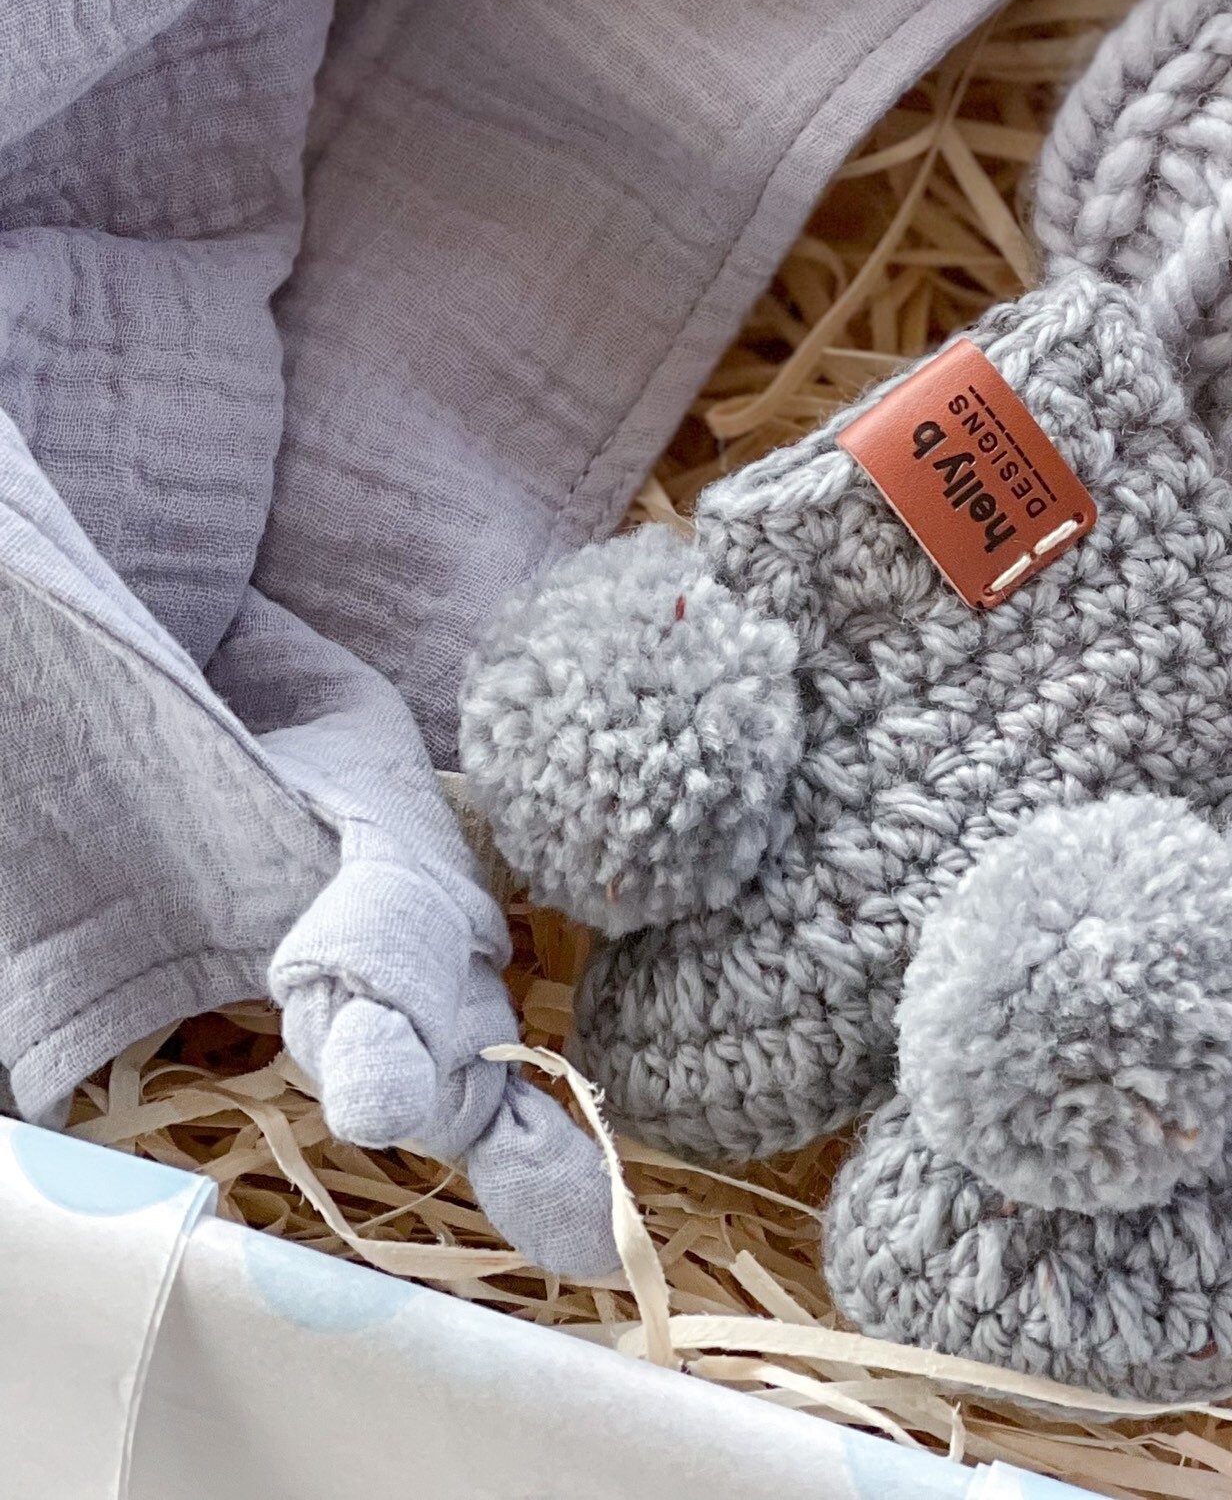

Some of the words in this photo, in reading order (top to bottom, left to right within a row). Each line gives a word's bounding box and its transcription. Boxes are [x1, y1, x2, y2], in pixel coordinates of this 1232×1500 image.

[912, 420, 947, 461] b
[947, 393, 1048, 519] DESIGNS
[932, 451, 1017, 554] helly
